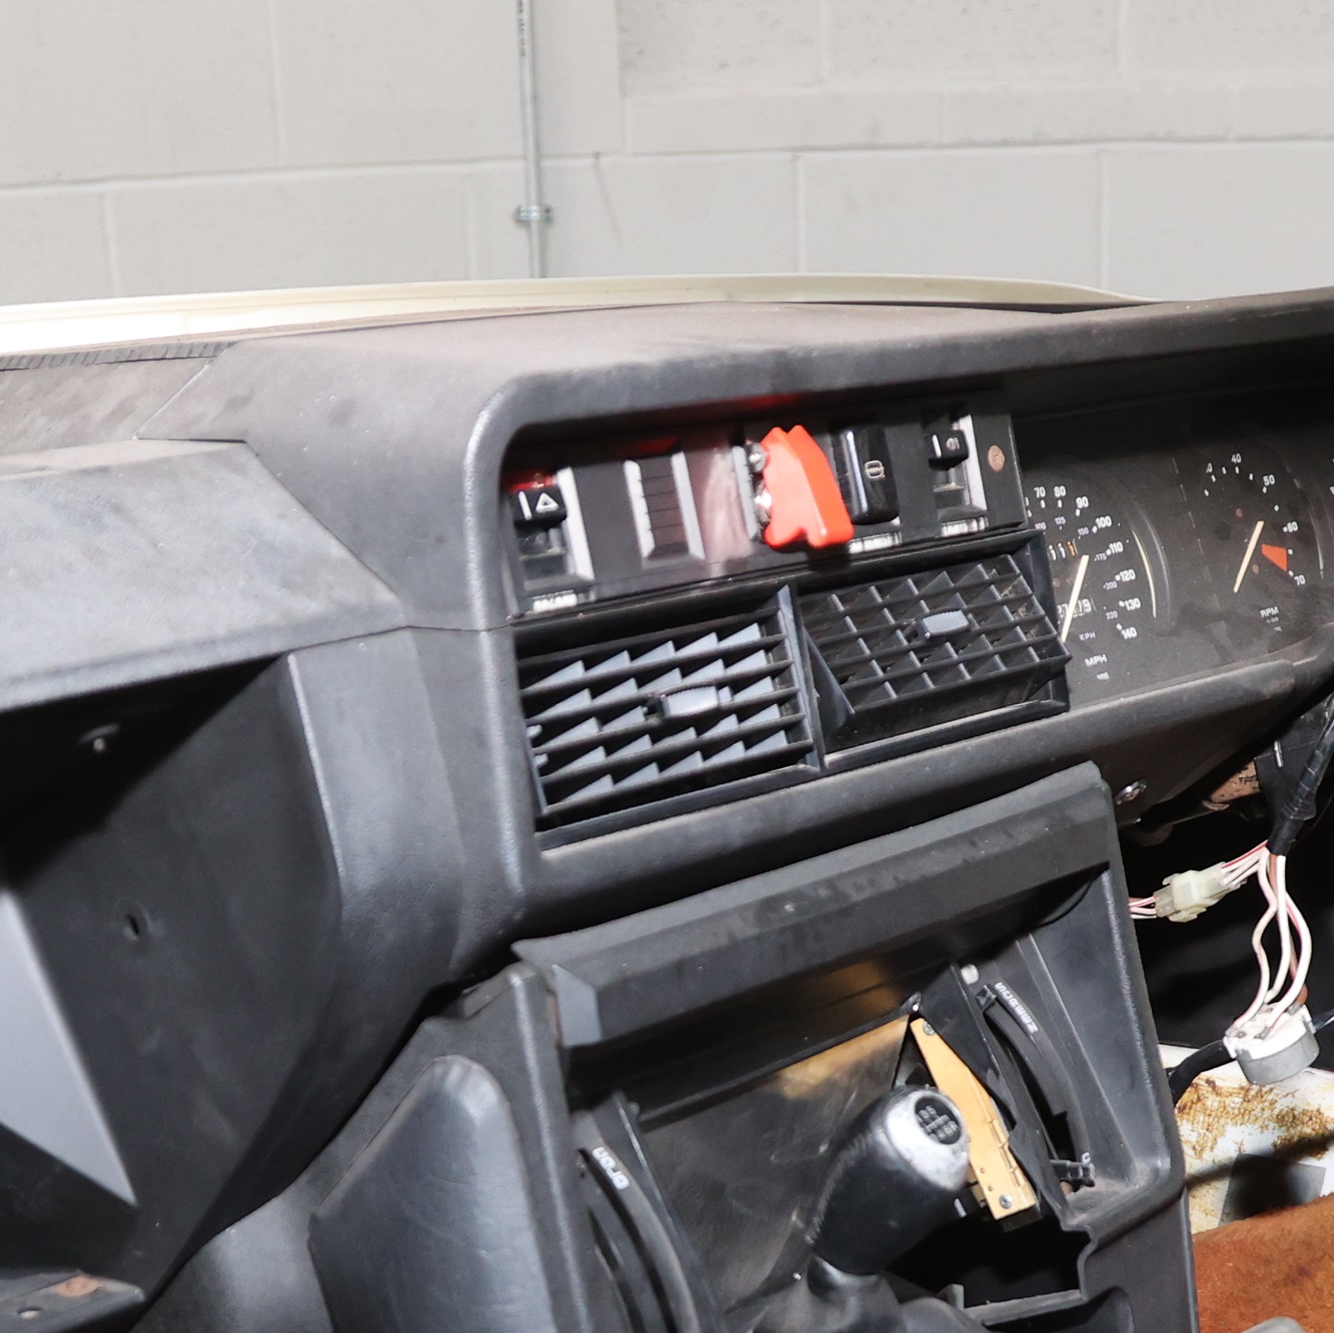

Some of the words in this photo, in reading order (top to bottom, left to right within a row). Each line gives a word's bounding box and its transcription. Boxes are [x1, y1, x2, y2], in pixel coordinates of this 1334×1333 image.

[1231, 453, 1242, 464] 40
[1263, 474, 1276, 486] 50
[1034, 486, 1046, 498] 70
[1054, 485, 1067, 498] 80
[1075, 496, 1089, 509] 90
[1095, 516, 1112, 529] 100
[1287, 521, 1299, 533] 60
[1077, 527, 1089, 536] 150
[1109, 541, 1124, 554] 110
[1095, 552, 1107, 561] 175
[1119, 569, 1136, 582] 120
[1294, 574, 1306, 586] 70
[1105, 581, 1118, 590] 200
[1124, 597, 1141, 611] 130
[1260, 606, 1280, 618] RPM
[1079, 631, 1096, 641] KPH
[1121, 627, 1138, 640] 140
[1085, 654, 1108, 667] MPH
